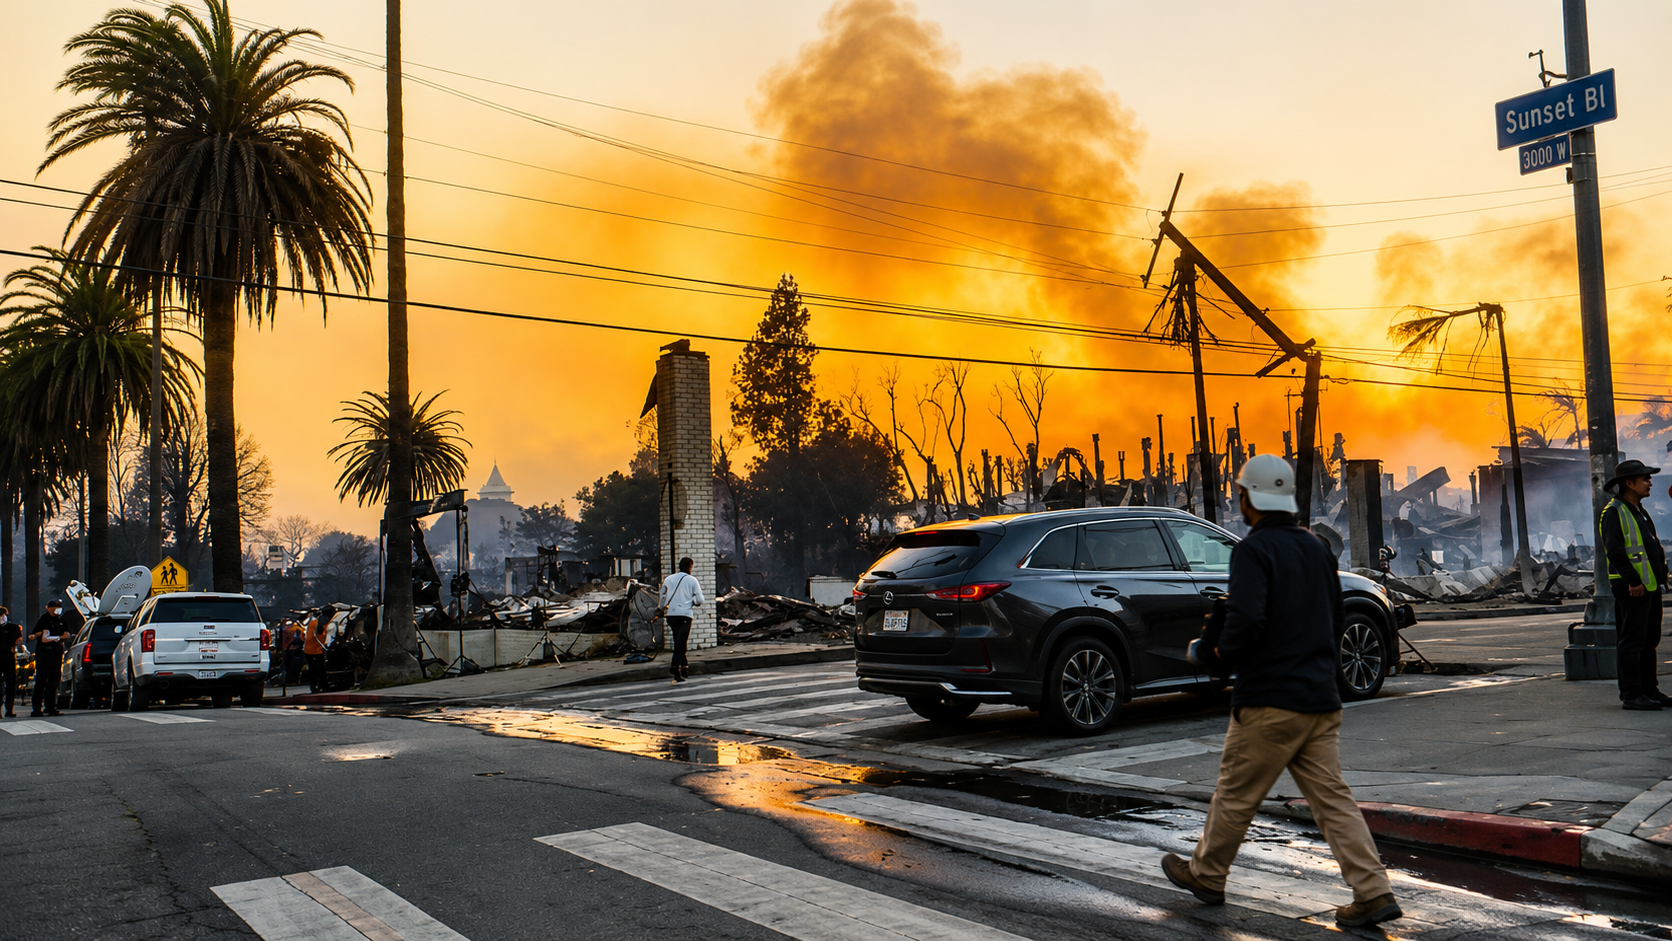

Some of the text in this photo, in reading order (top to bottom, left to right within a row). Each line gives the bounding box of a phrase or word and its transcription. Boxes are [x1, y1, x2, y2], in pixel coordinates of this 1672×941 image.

[1506, 84, 1606, 134] Sunset Bl
[1523, 141, 1567, 169] 3000 W
